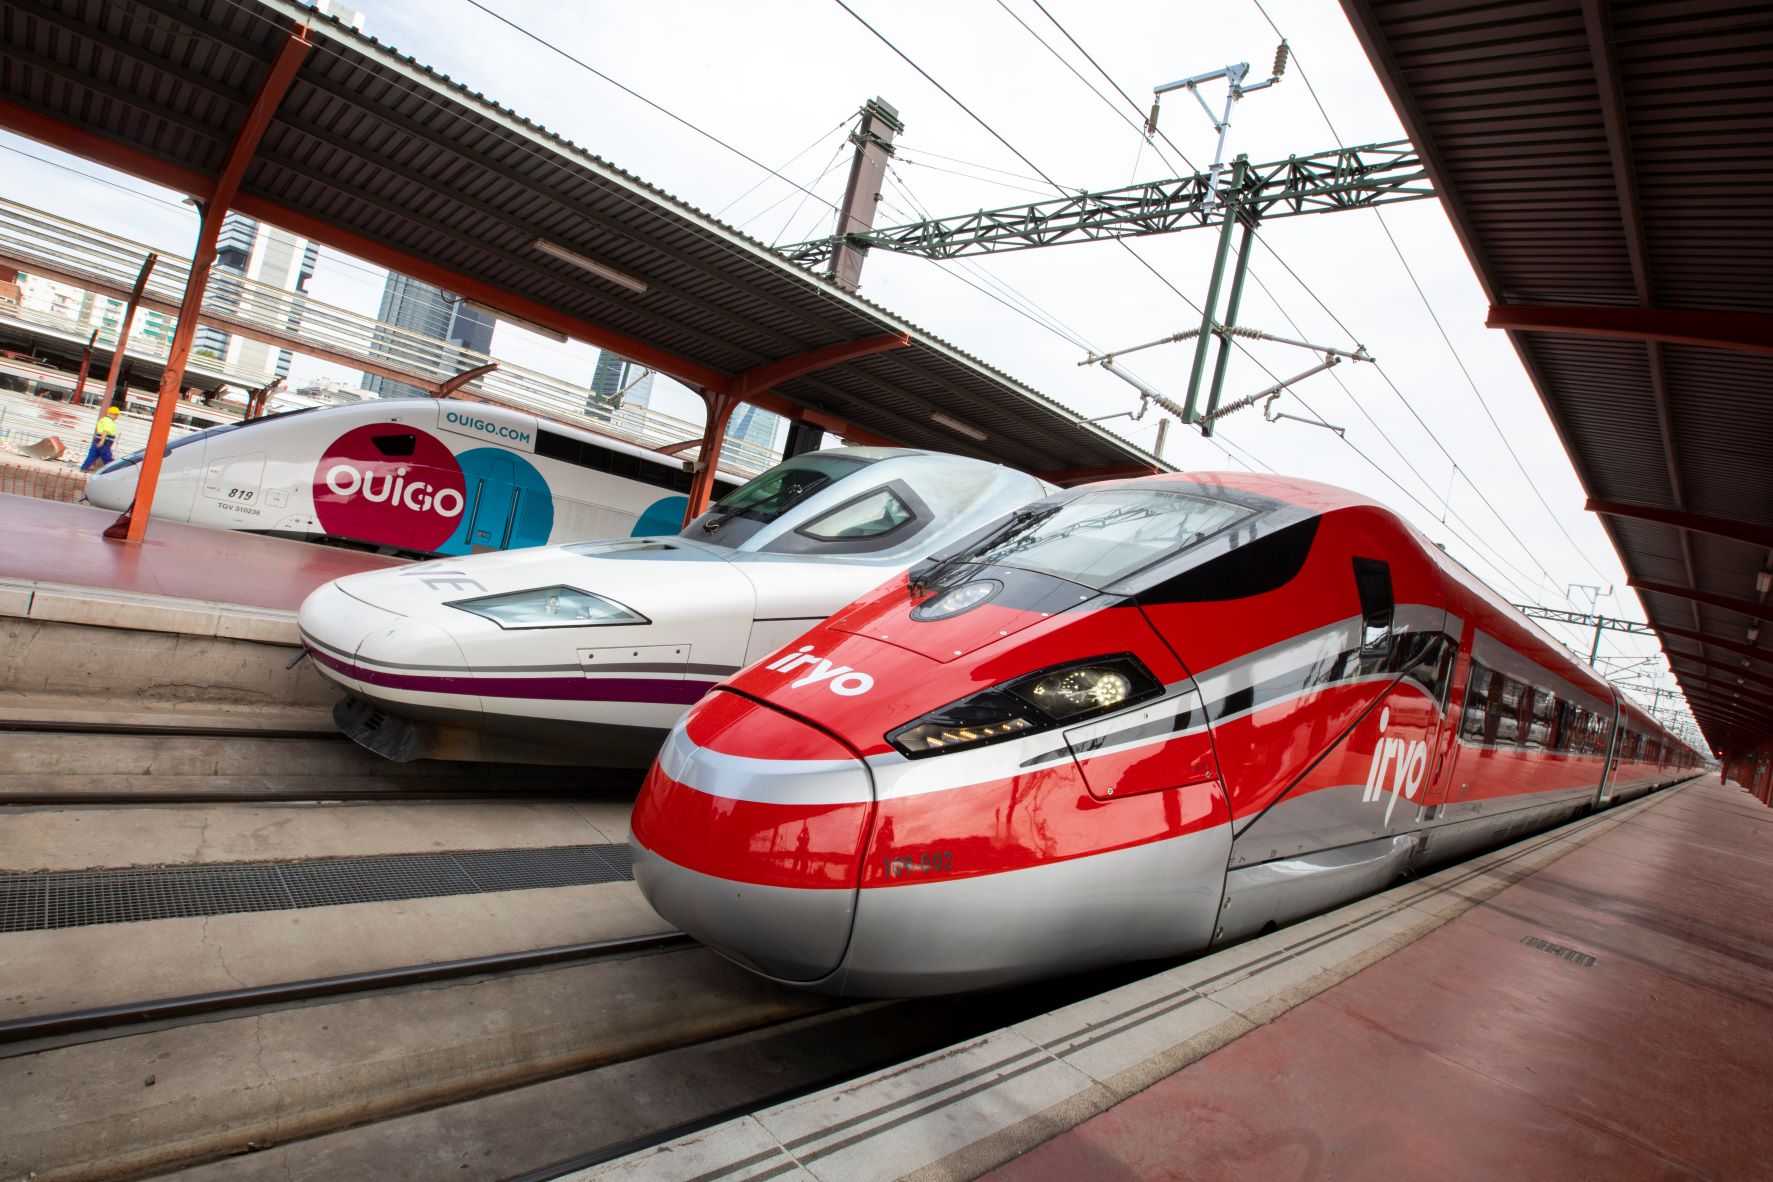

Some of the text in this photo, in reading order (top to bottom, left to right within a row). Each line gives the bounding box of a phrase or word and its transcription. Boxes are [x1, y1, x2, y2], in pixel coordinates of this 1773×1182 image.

[446, 411, 531, 444] OUIGO.COM
[218, 502, 234, 510] TGV
[228, 488, 254, 501] 819
[765, 645, 874, 696] iryo
[1362, 706, 1427, 828] iryo
